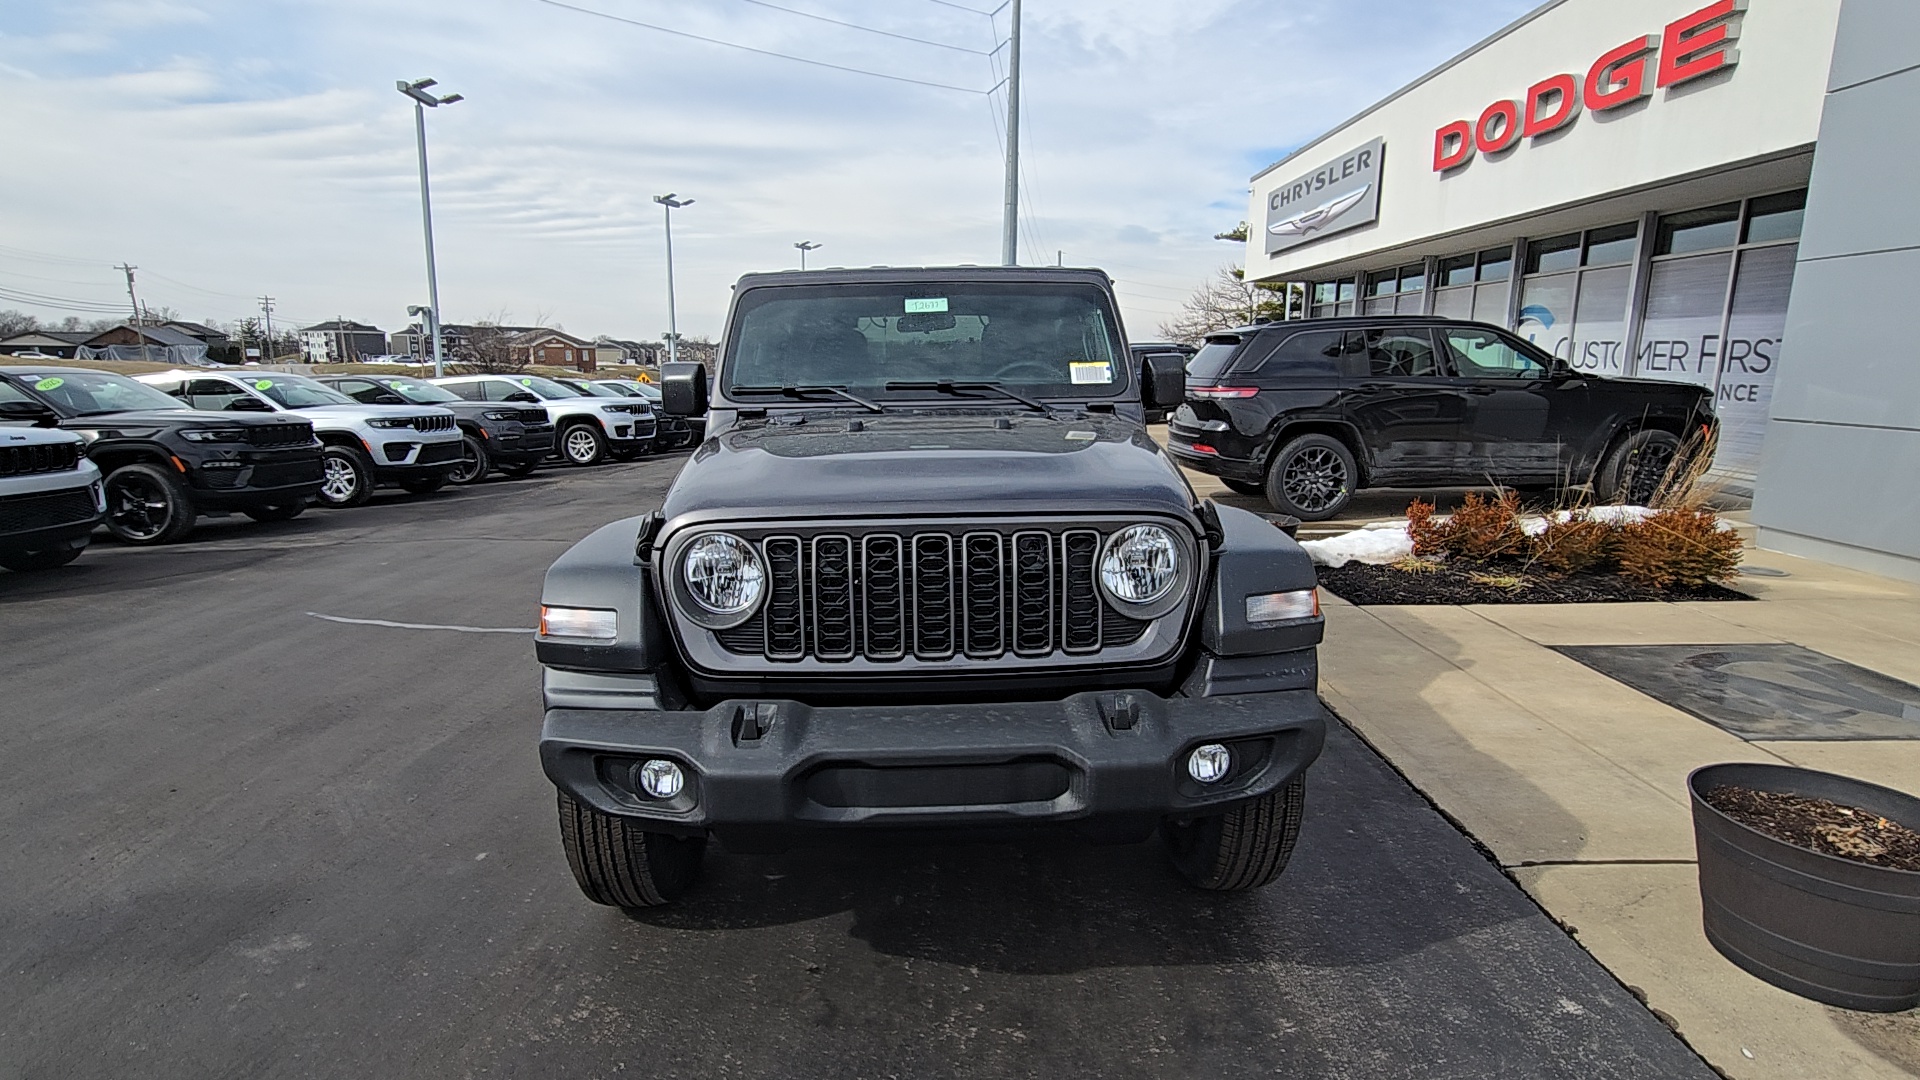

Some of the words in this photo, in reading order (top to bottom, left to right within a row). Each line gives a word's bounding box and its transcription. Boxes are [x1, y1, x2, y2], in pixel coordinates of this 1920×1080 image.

[1433, 0, 1740, 172] DODGE
[1271, 149, 1372, 211] CHRYSLER
[1697, 334, 1783, 374] FIRS
